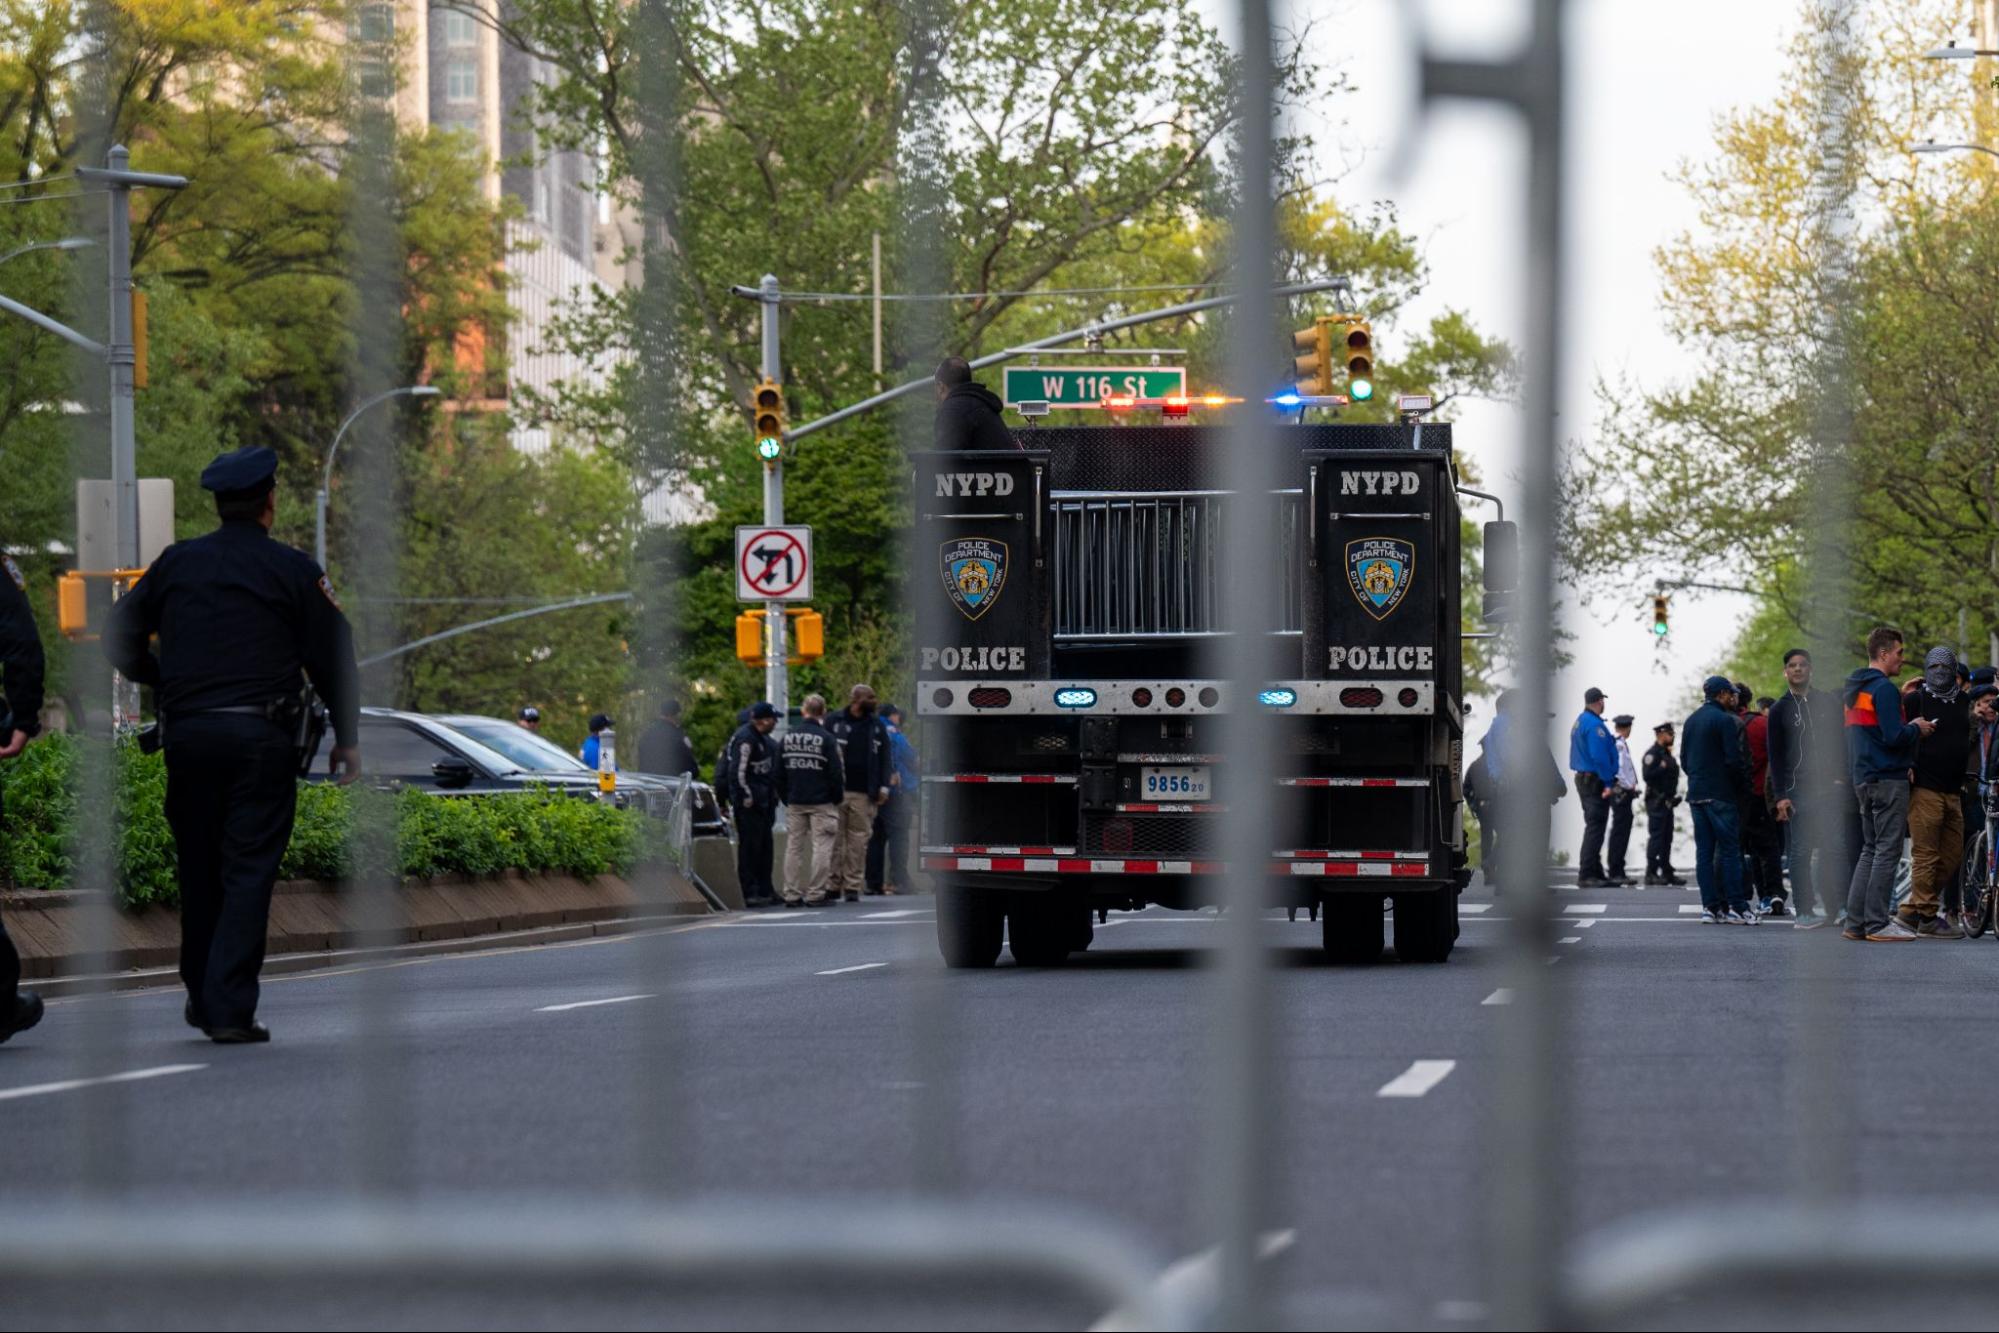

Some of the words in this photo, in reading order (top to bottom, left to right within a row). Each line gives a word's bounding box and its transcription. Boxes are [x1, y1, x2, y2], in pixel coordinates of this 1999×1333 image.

[1042, 376, 1064, 399] W
[1076, 376, 1112, 399] 116
[1124, 376, 1147, 399] St
[935, 473, 1014, 497] NYPD
[1340, 471, 1420, 495] NYPD
[945, 549, 1003, 563] DEPARTMENT
[958, 541, 989, 550] POLICE
[1351, 549, 1409, 563] DEPARTMENT
[1363, 541, 1396, 550] POLICE
[945, 571, 956, 591] CITY
[953, 591, 963, 602] OF
[982, 588, 996, 606] NEW
[993, 568, 1004, 588] YORK
[1350, 570, 1361, 591] CITY
[1359, 591, 1370, 602] OF
[1388, 588, 1402, 606] NEW
[1399, 567, 1410, 588] YORK
[920, 647, 1025, 671] POLICE
[1328, 646, 1433, 670] POLICE
[784, 733, 823, 745] NYPD
[784, 744, 822, 754] POLICE
